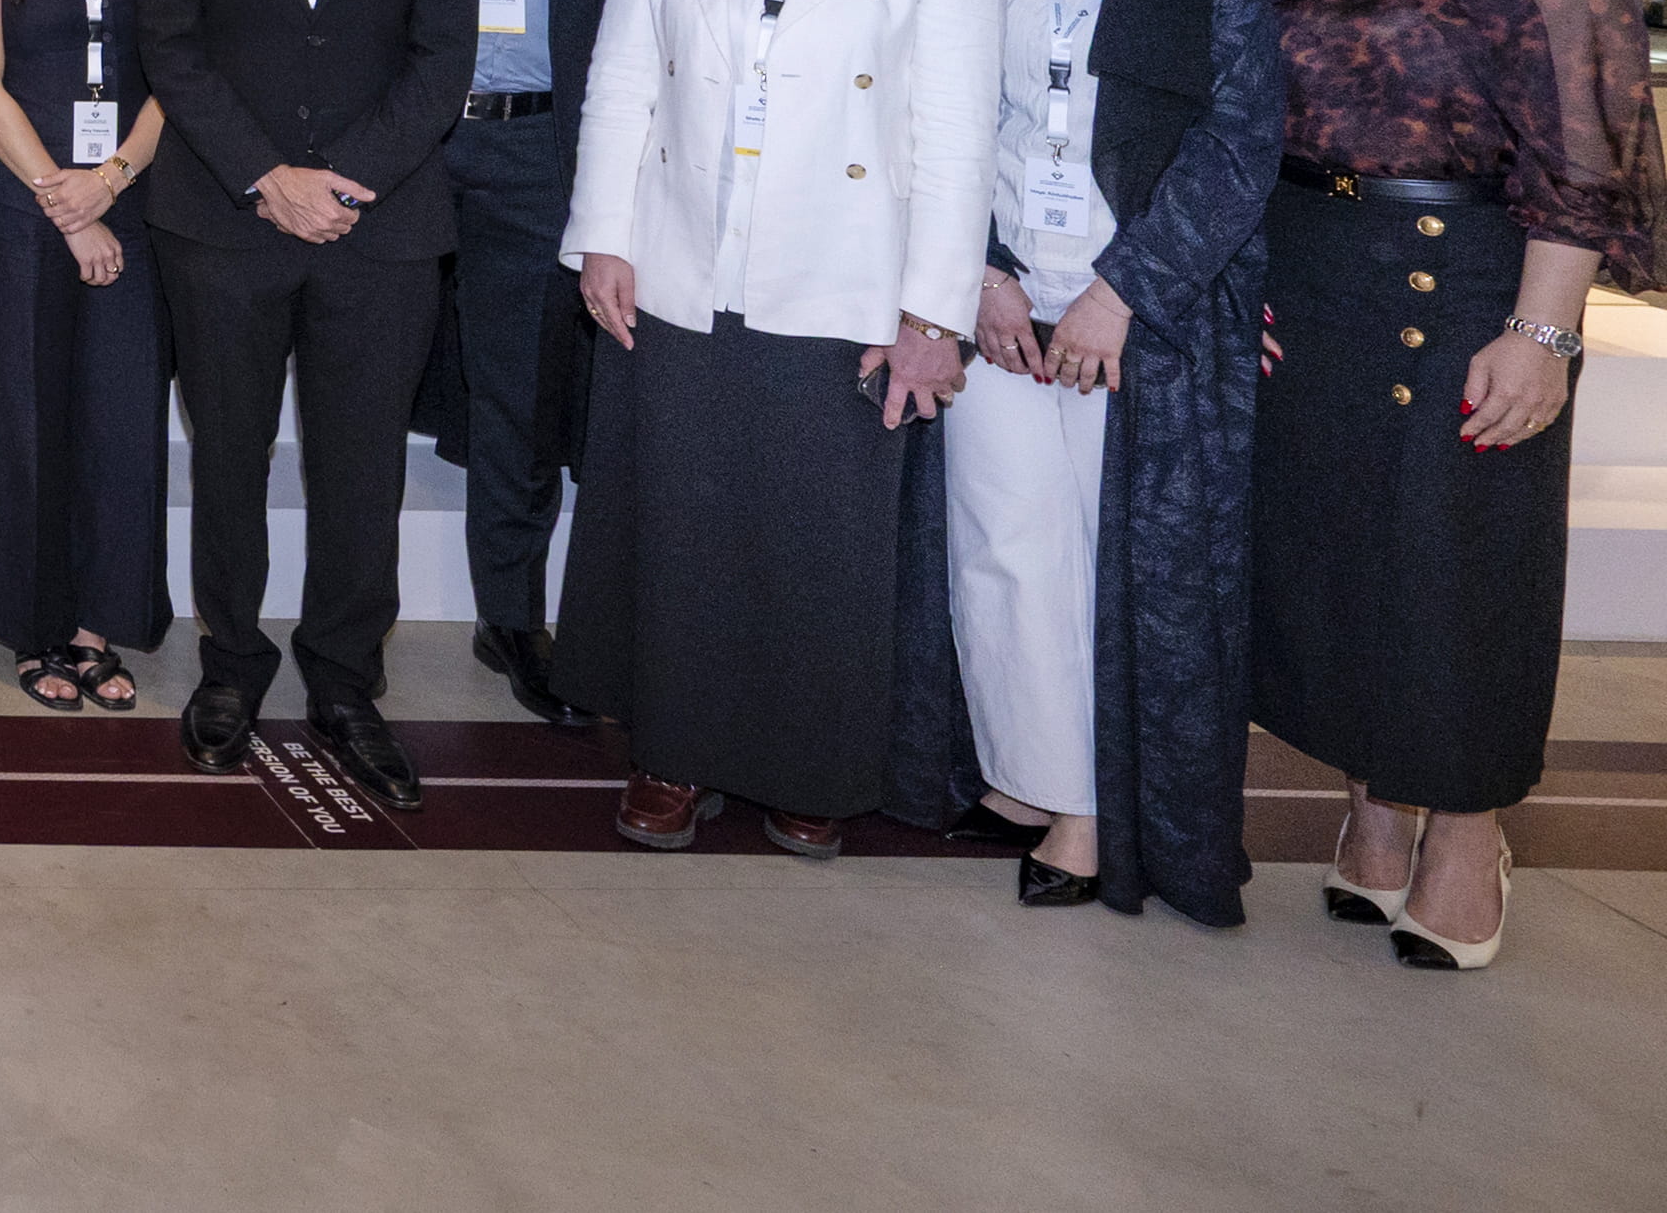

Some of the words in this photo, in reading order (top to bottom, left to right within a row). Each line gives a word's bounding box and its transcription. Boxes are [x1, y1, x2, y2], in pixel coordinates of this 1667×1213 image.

[282, 742, 313, 759] BE
[301, 760, 339, 786] THE
[325, 788, 373, 822] BEST
[288, 786, 319, 804] OF
[307, 806, 346, 834] YOU
